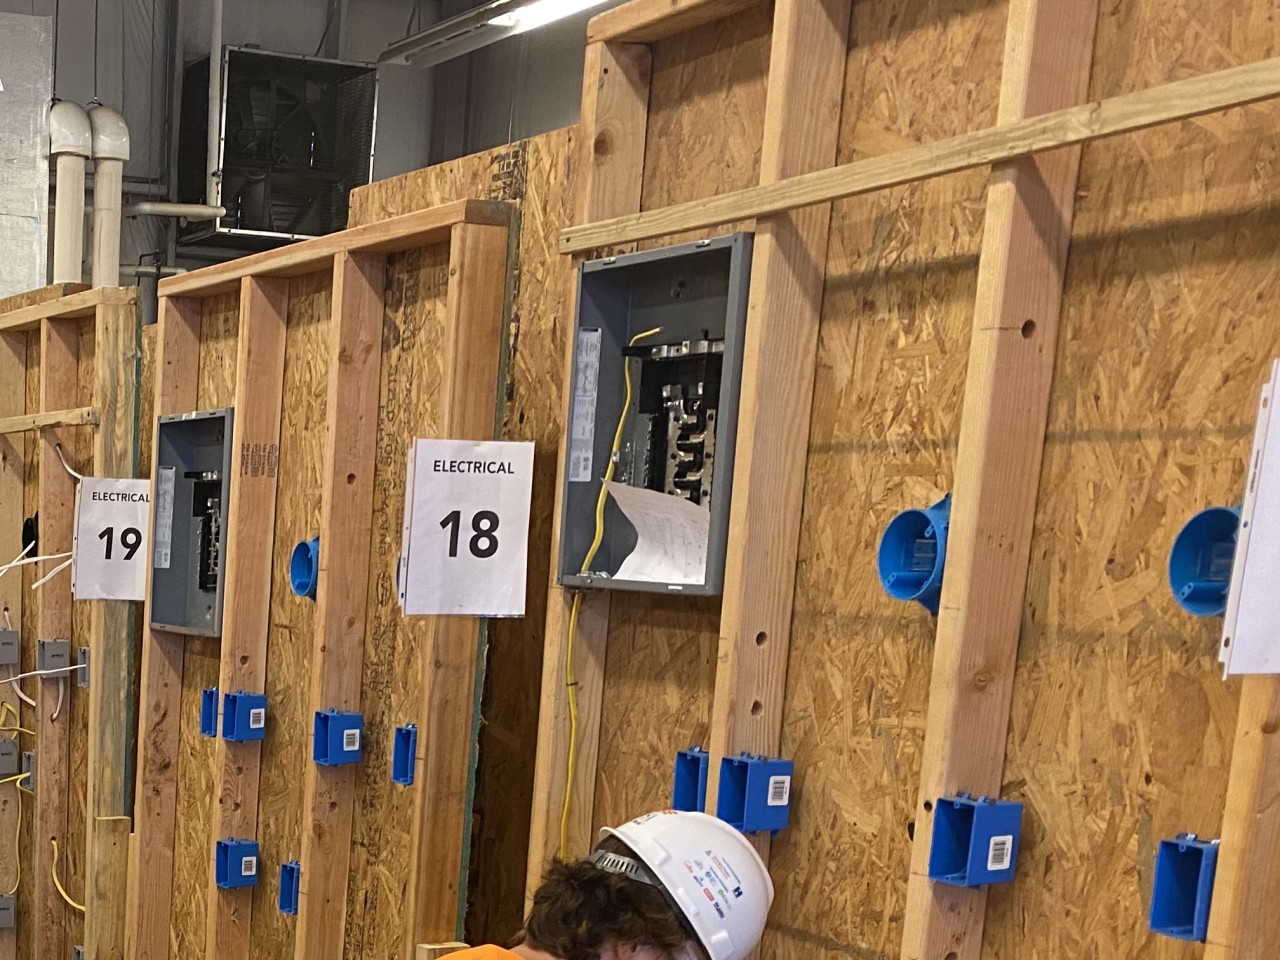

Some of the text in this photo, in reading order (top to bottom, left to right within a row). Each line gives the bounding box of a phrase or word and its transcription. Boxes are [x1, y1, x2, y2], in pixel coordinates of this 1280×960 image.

[433, 460, 515, 474] ELECTRICAL
[92, 491, 150, 503] ELECTRICAL
[98, 526, 142, 561] 19
[439, 510, 500, 559] 18
